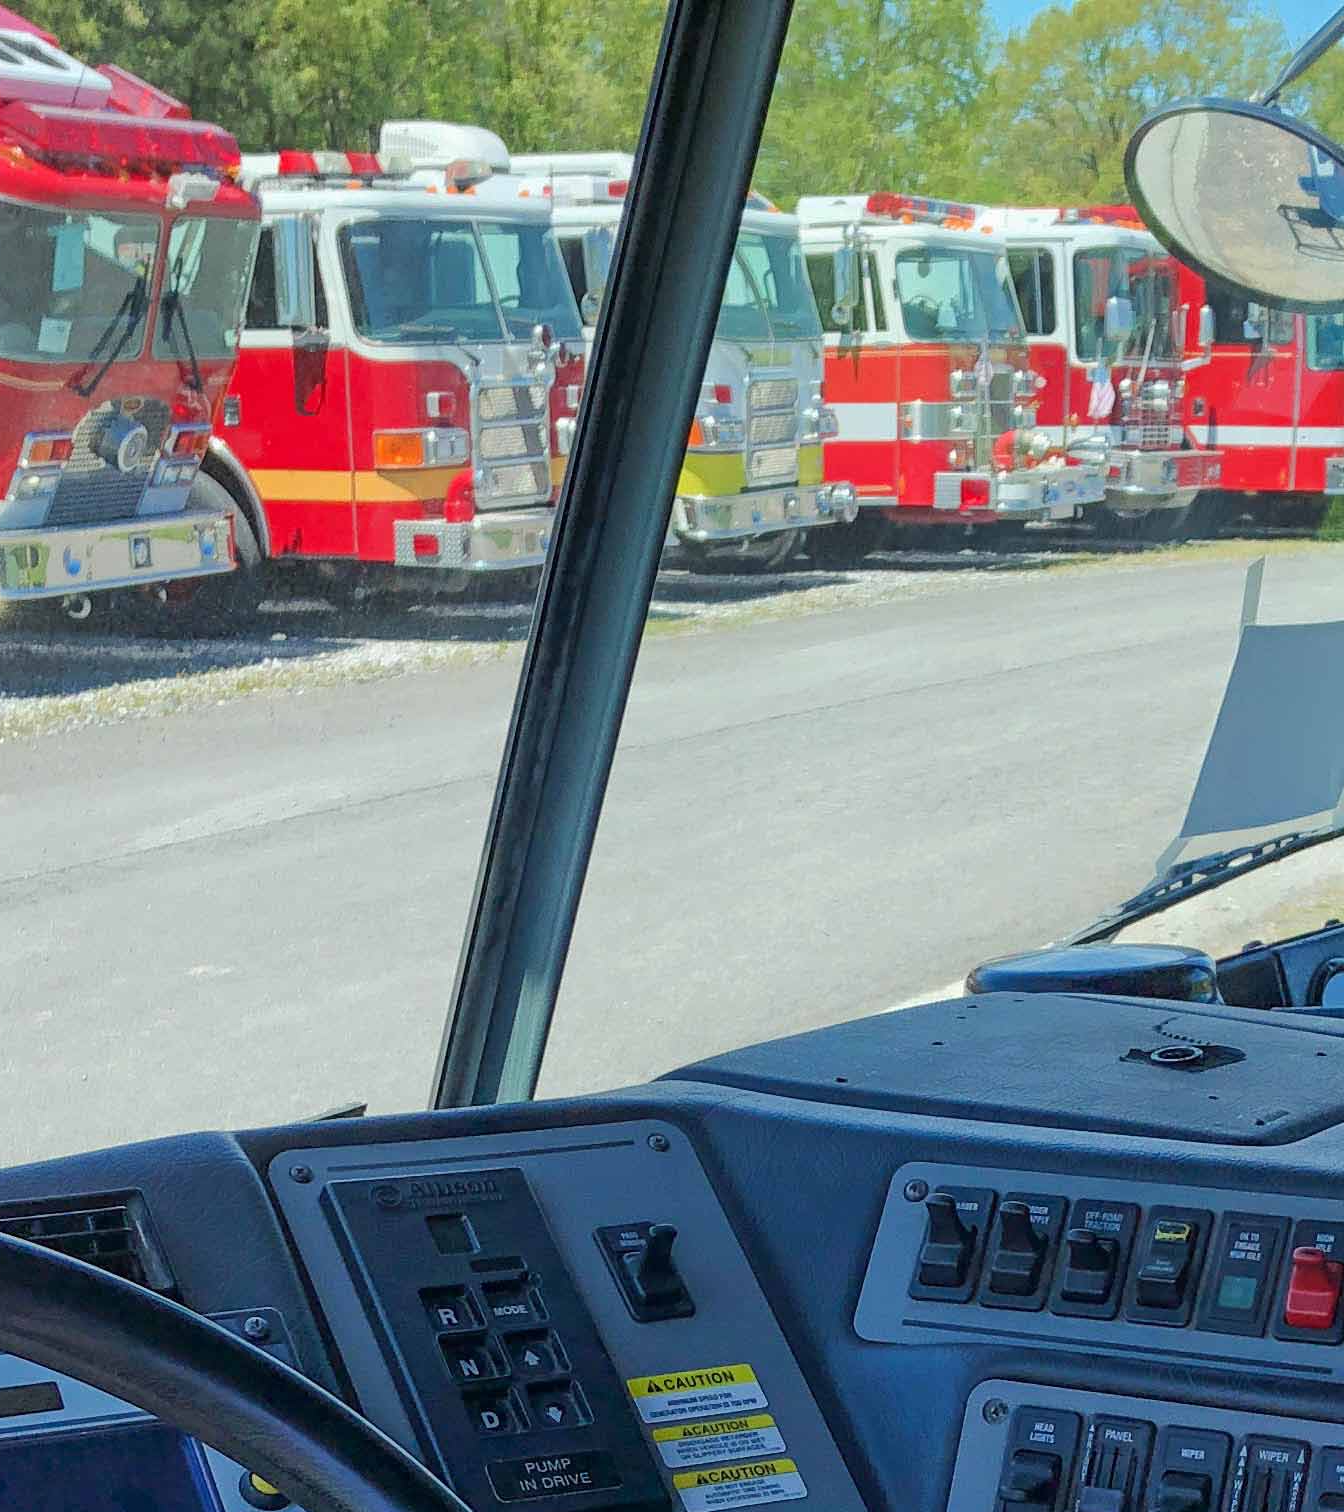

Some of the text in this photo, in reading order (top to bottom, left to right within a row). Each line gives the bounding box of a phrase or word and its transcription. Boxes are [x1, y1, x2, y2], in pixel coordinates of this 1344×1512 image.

[438, 1307, 458, 1326] R
[493, 1304, 529, 1316] MODE
[459, 1359, 481, 1377] N
[663, 1370, 735, 1391] CAUTION
[481, 1411, 500, 1429] D
[692, 1419, 749, 1437] CAUTION
[1034, 1422, 1055, 1433] HEAD
[1029, 1432, 1056, 1444] LIGHTS
[1105, 1429, 1135, 1442] PANEL
[1181, 1448, 1206, 1460] WIPER
[1259, 1450, 1289, 1463] WIPER
[524, 1458, 572, 1475] PUMP
[708, 1463, 777, 1483] CAUTION
[520, 1471, 593, 1492] IN DRIVE
